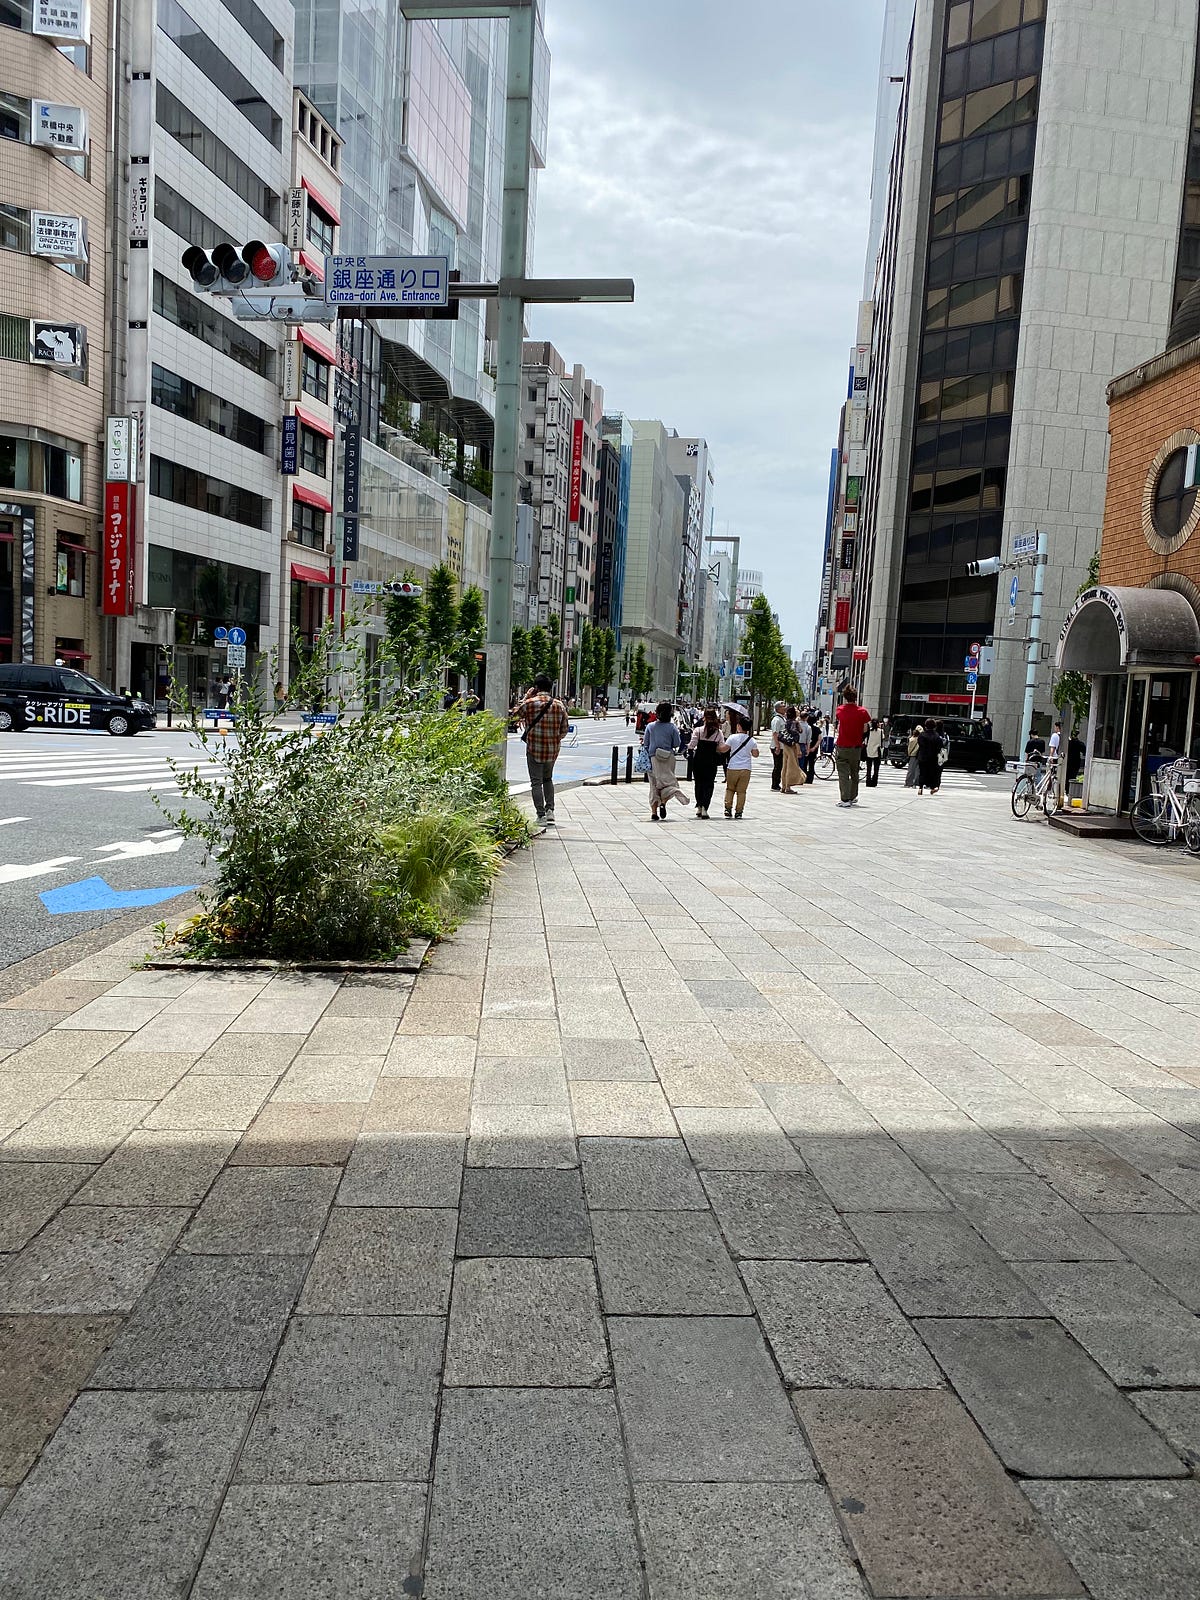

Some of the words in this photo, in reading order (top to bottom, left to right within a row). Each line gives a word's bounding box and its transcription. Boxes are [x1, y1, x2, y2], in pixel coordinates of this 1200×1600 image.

[41, 119, 74, 132] 京橋中央
[49, 132, 74, 144] 不動産
[137, 156, 143, 164] 5
[139, 177, 148, 222] ギャラリー
[291, 189, 302, 228] 近藤丸人
[38, 218, 74, 230] 銀座シティ
[36, 226, 77, 239] 法律事務所
[39, 237, 58, 245] GINZA
[135, 240, 142, 249] 4
[53, 244, 74, 252] OFFICE
[333, 257, 366, 267] 中央区
[333, 269, 440, 289] 銀座通り口
[330, 290, 376, 301] Ginza-dori
[380, 290, 398, 302] Ave.
[402, 290, 440, 301] Entrance
[284, 419, 296, 472] 藤見歯科
[348, 432, 356, 503] KIRARITO
[109, 513, 123, 603] コージーコーナー
[1099, 590, 1119, 612] POLICE
[1116, 612, 1125, 635] BOX
[24, 706, 91, 725] S.RIDE
